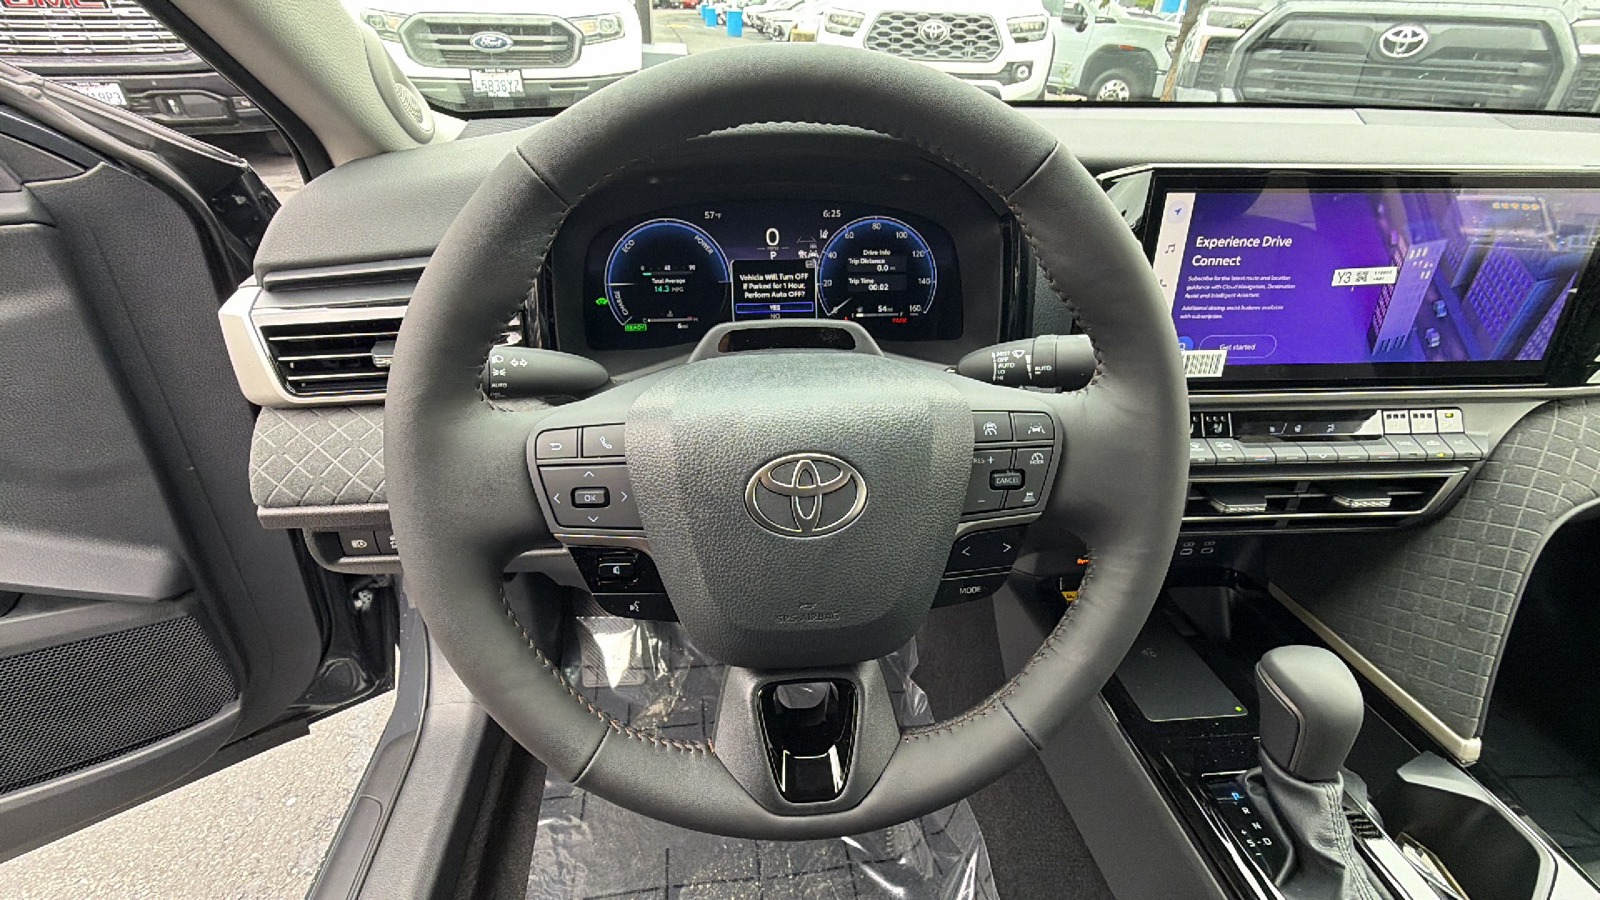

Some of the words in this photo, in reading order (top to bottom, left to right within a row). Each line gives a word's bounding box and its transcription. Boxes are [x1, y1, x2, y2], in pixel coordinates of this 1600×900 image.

[822, 210, 841, 218] 6:25
[766, 228, 780, 246] 0
[844, 231, 854, 239] 60
[896, 231, 908, 239] 100
[621, 239, 635, 254] ECO
[694, 234, 714, 256] POWER
[1196, 235, 1260, 250] Experience
[1262, 234, 1292, 248] Drive
[770, 252, 777, 260] P
[1192, 254, 1242, 266] Connect
[1338, 271, 1352, 284] Y3
[960, 586, 982, 595] MODE
[800, 612, 840, 622] AIRBAG
[1231, 792, 1240, 800] P
[1241, 806, 1250, 815] R
[1252, 822, 1262, 830] N
[1246, 839, 1256, 848] S
[1262, 837, 1272, 846] D
